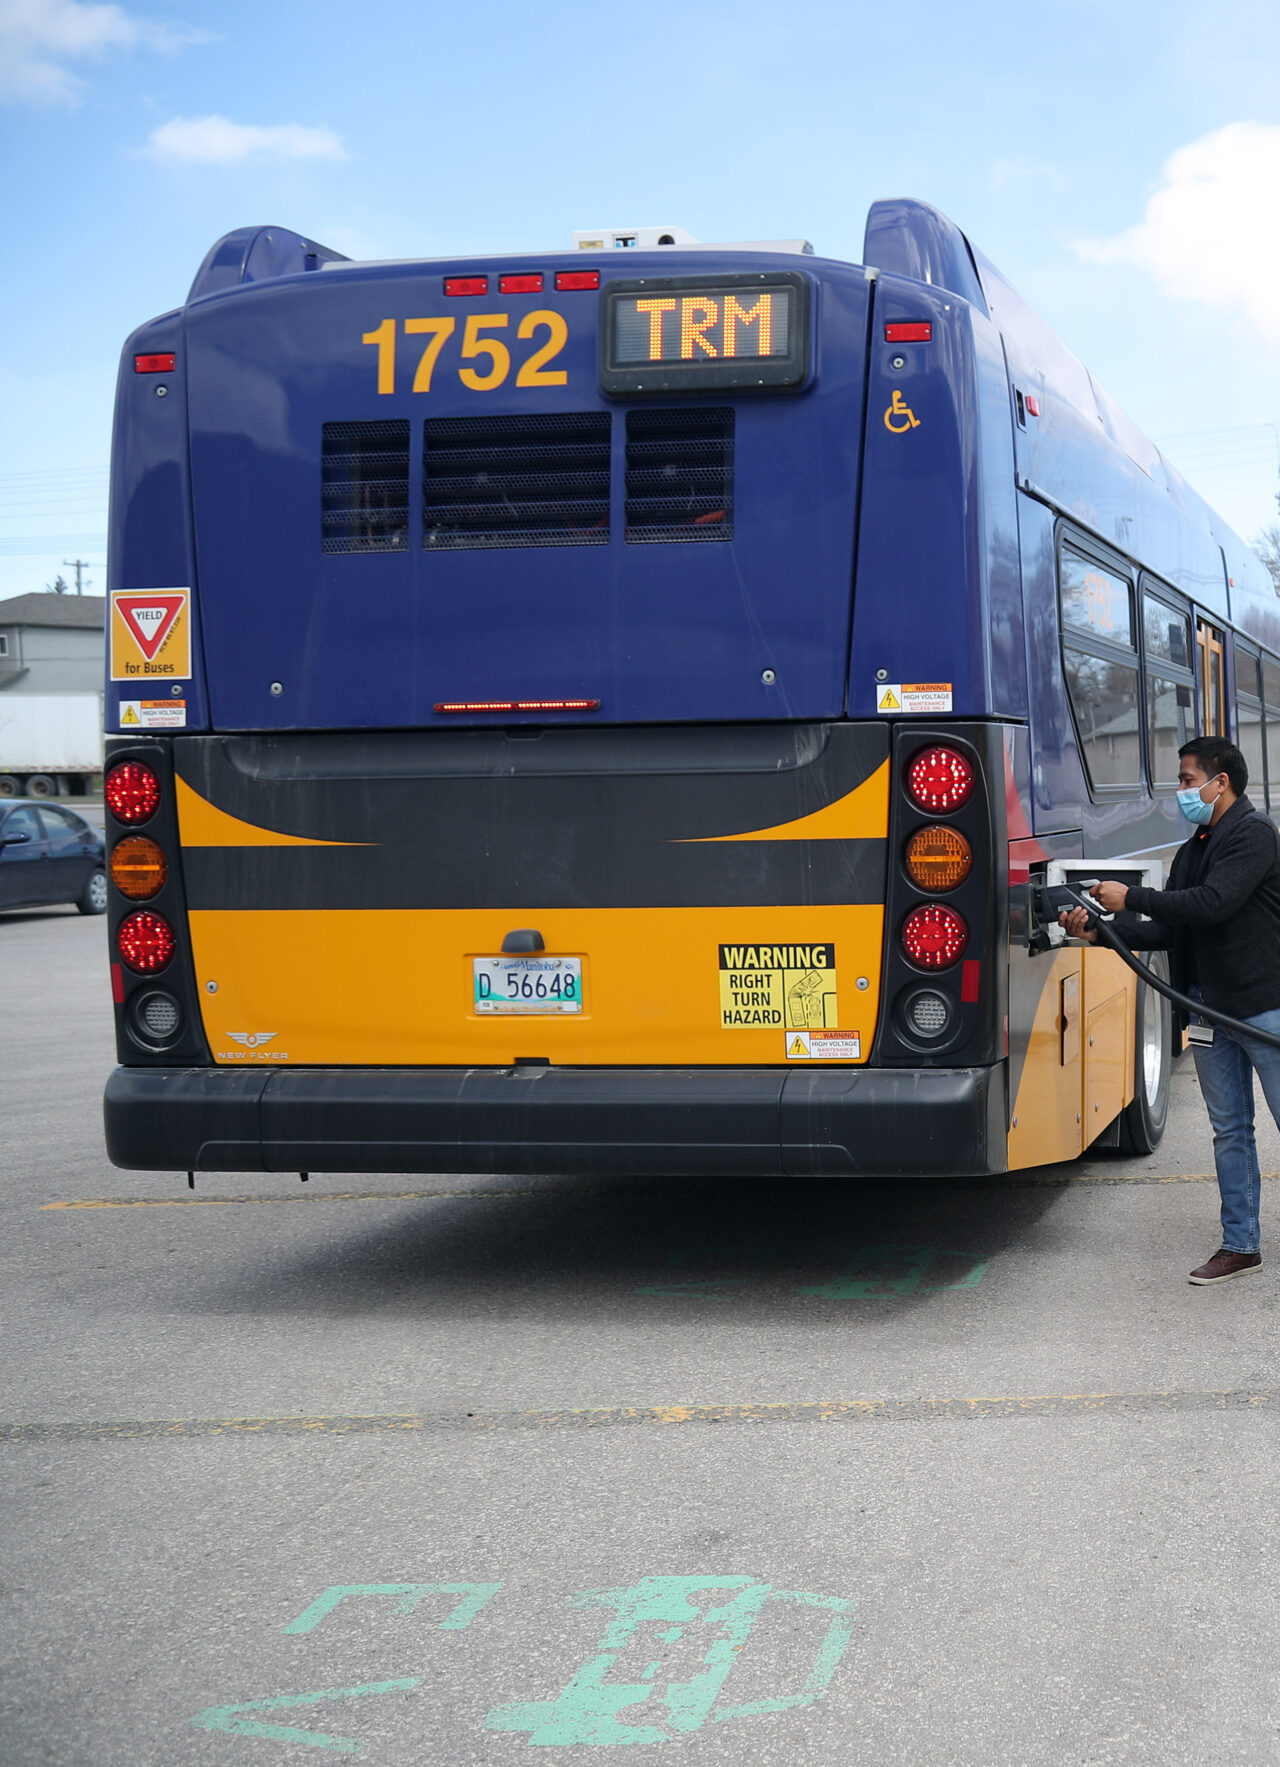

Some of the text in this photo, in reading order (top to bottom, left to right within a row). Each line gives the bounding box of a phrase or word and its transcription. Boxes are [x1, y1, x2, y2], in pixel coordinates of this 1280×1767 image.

[636, 295, 773, 361] TRM
[362, 310, 569, 395] 1752
[136, 611, 162, 620] YIELD
[125, 662, 175, 674] for Buses
[723, 946, 827, 968] WARNING
[521, 960, 555, 971] Manitoba
[479, 973, 576, 998] D 56648
[729, 974, 773, 988] RIGHT
[732, 992, 771, 1006] TURN
[723, 1010, 782, 1024] HAZARD
